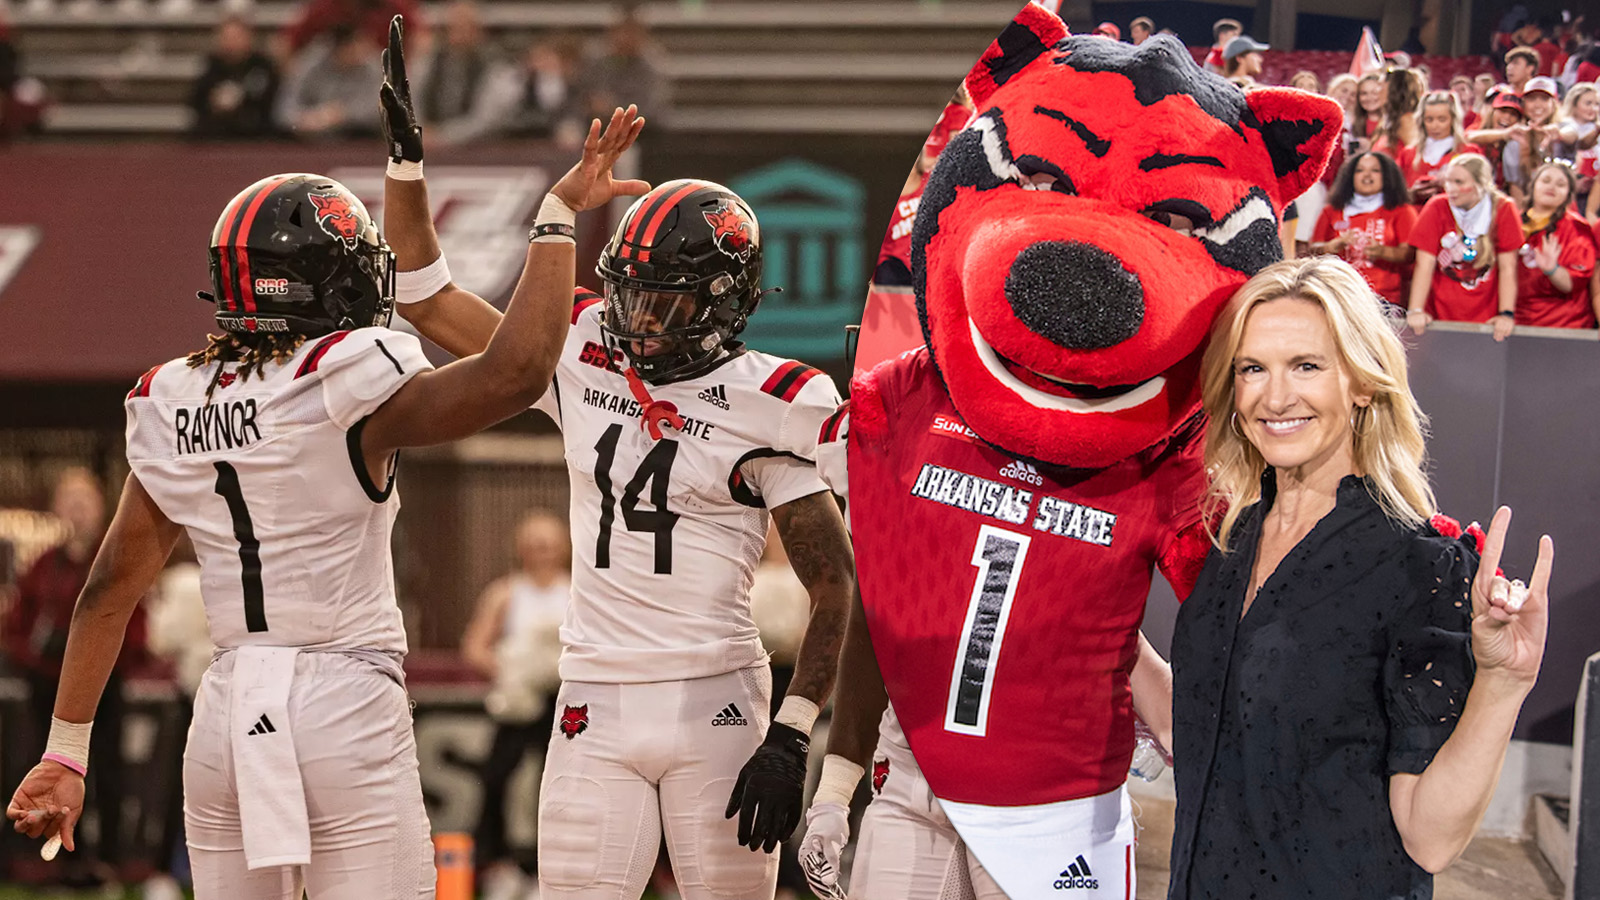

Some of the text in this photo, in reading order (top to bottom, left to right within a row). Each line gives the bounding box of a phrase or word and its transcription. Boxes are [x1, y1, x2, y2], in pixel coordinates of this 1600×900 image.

[255, 278, 288, 295] SBC
[698, 391, 730, 411] adidas
[175, 398, 262, 455] RAYNOR
[933, 417, 964, 434] SUN
[999, 464, 1043, 487] adidas
[594, 422, 681, 575] 14
[910, 462, 1118, 547] ARKANSAS STATE
[213, 460, 268, 633] 1
[944, 524, 1032, 737] 1
[711, 716, 748, 727] adidas
[1053, 876, 1099, 890] adidas
